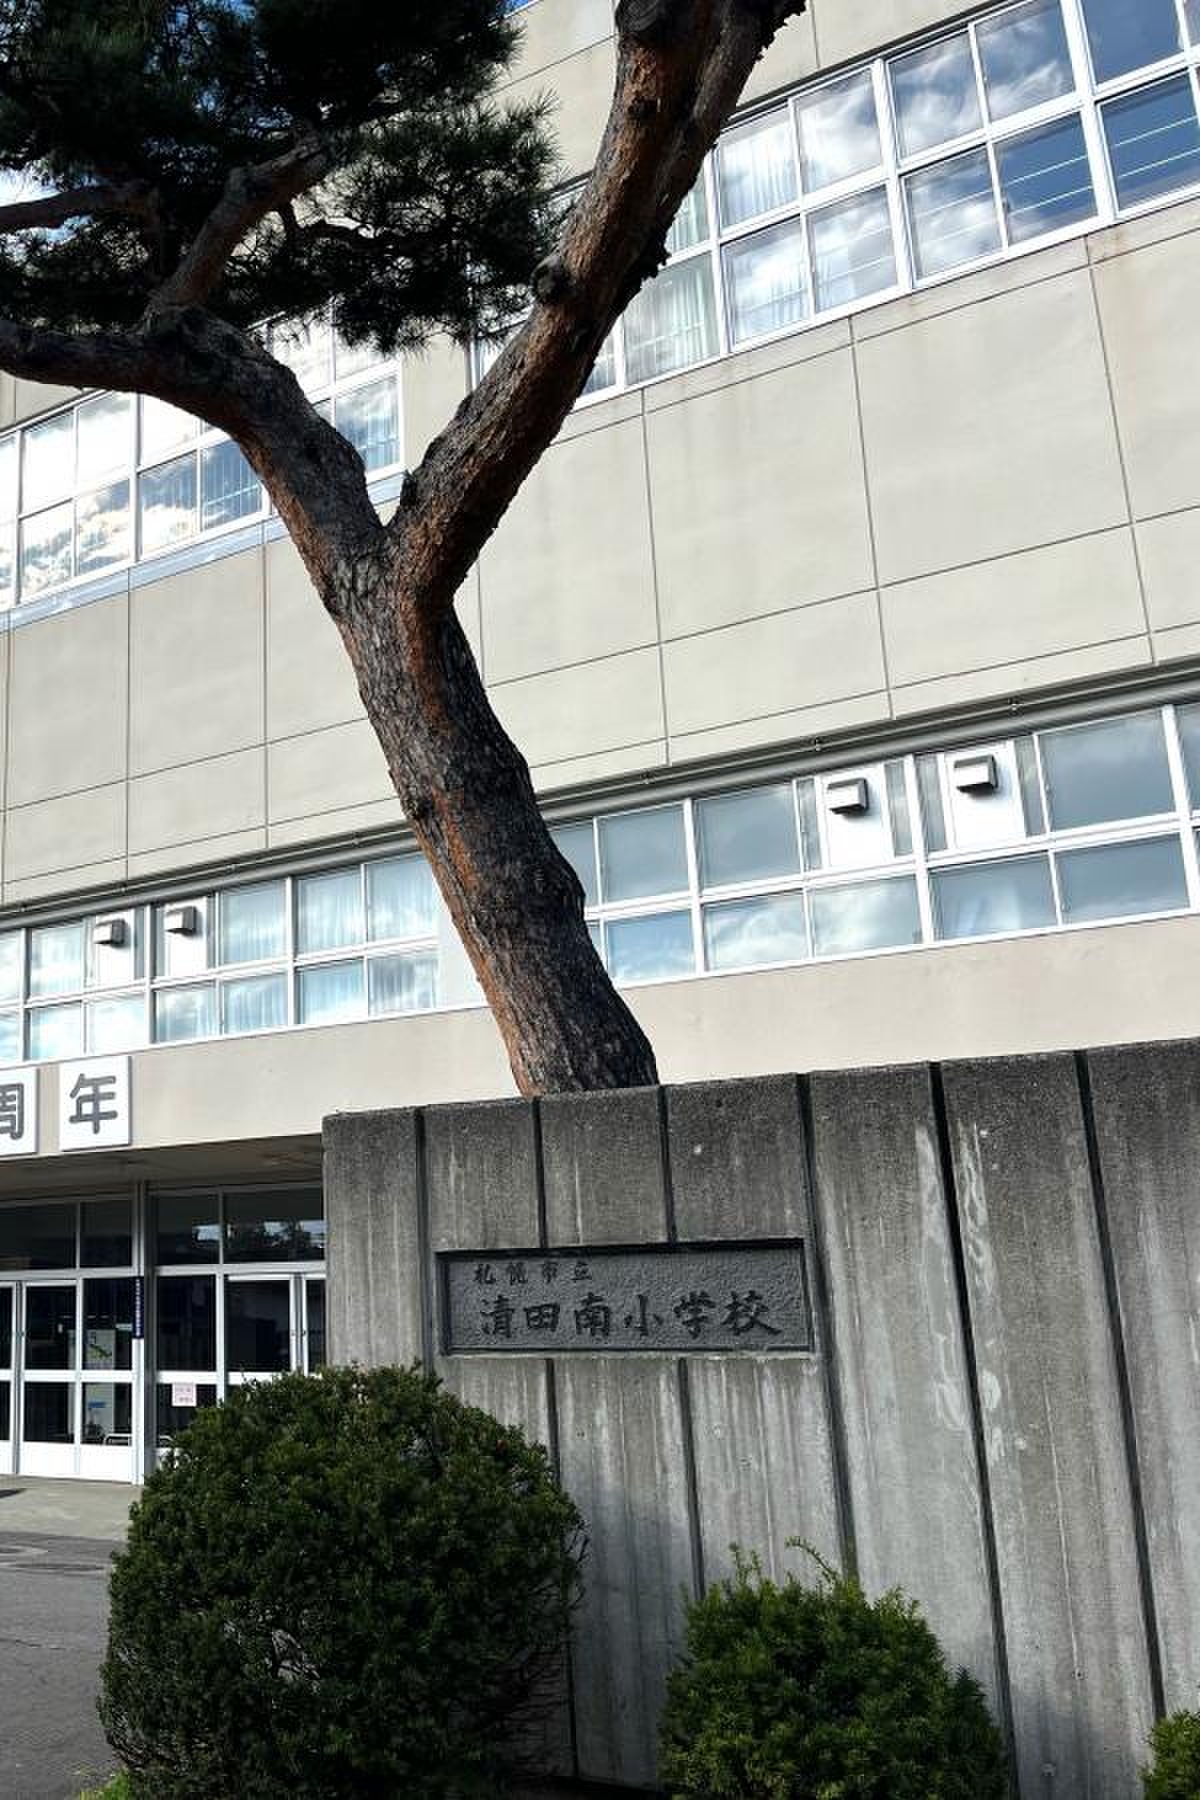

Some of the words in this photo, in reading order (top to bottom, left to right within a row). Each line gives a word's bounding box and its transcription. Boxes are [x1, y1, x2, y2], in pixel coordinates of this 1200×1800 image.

[481, 1289, 782, 1340] 清田南小学校
